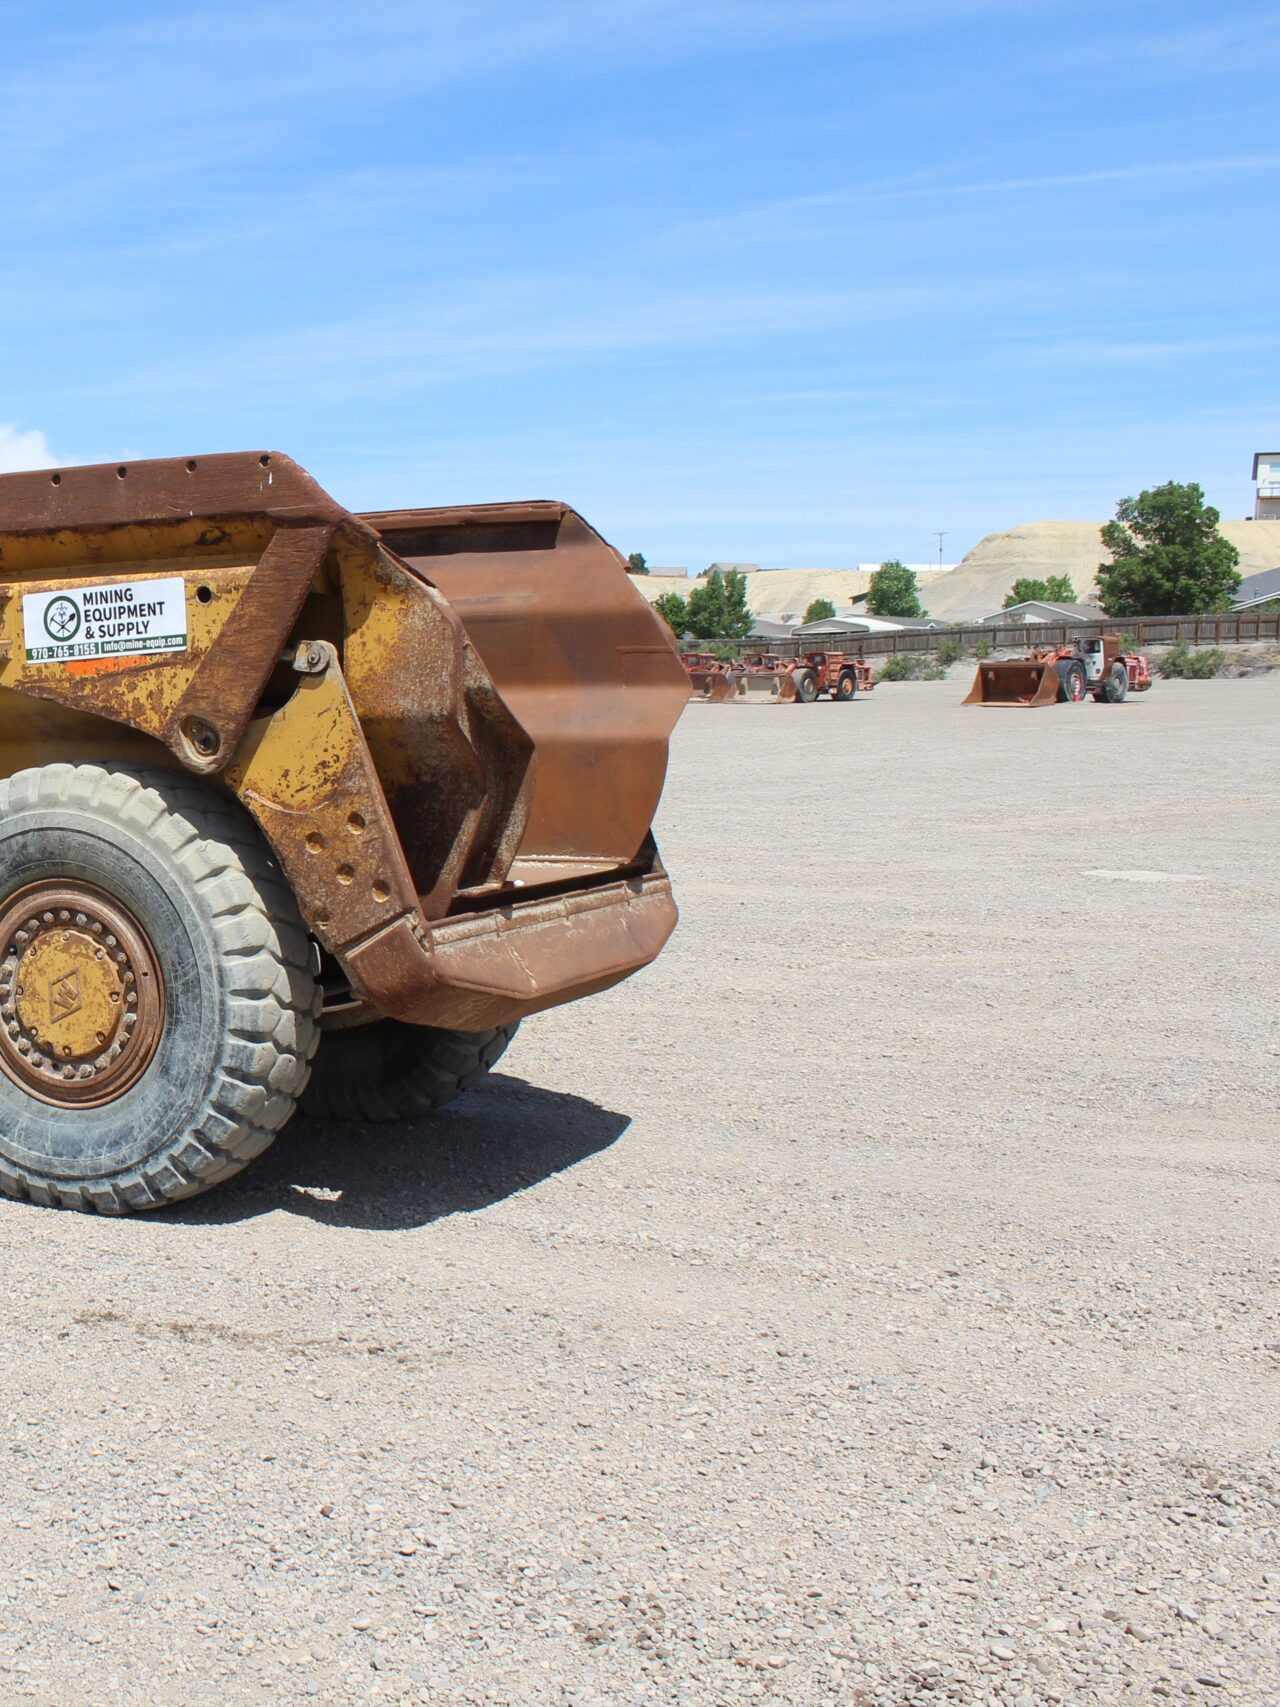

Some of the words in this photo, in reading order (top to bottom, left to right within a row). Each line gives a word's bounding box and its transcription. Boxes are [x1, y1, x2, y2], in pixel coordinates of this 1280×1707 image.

[83, 588, 133, 606] MINING
[84, 601, 165, 622] EQUIPMENT
[85, 626, 95, 639] &
[98, 620, 150, 638] SUPPLY
[32, 643, 96, 659] 970-765-8155
